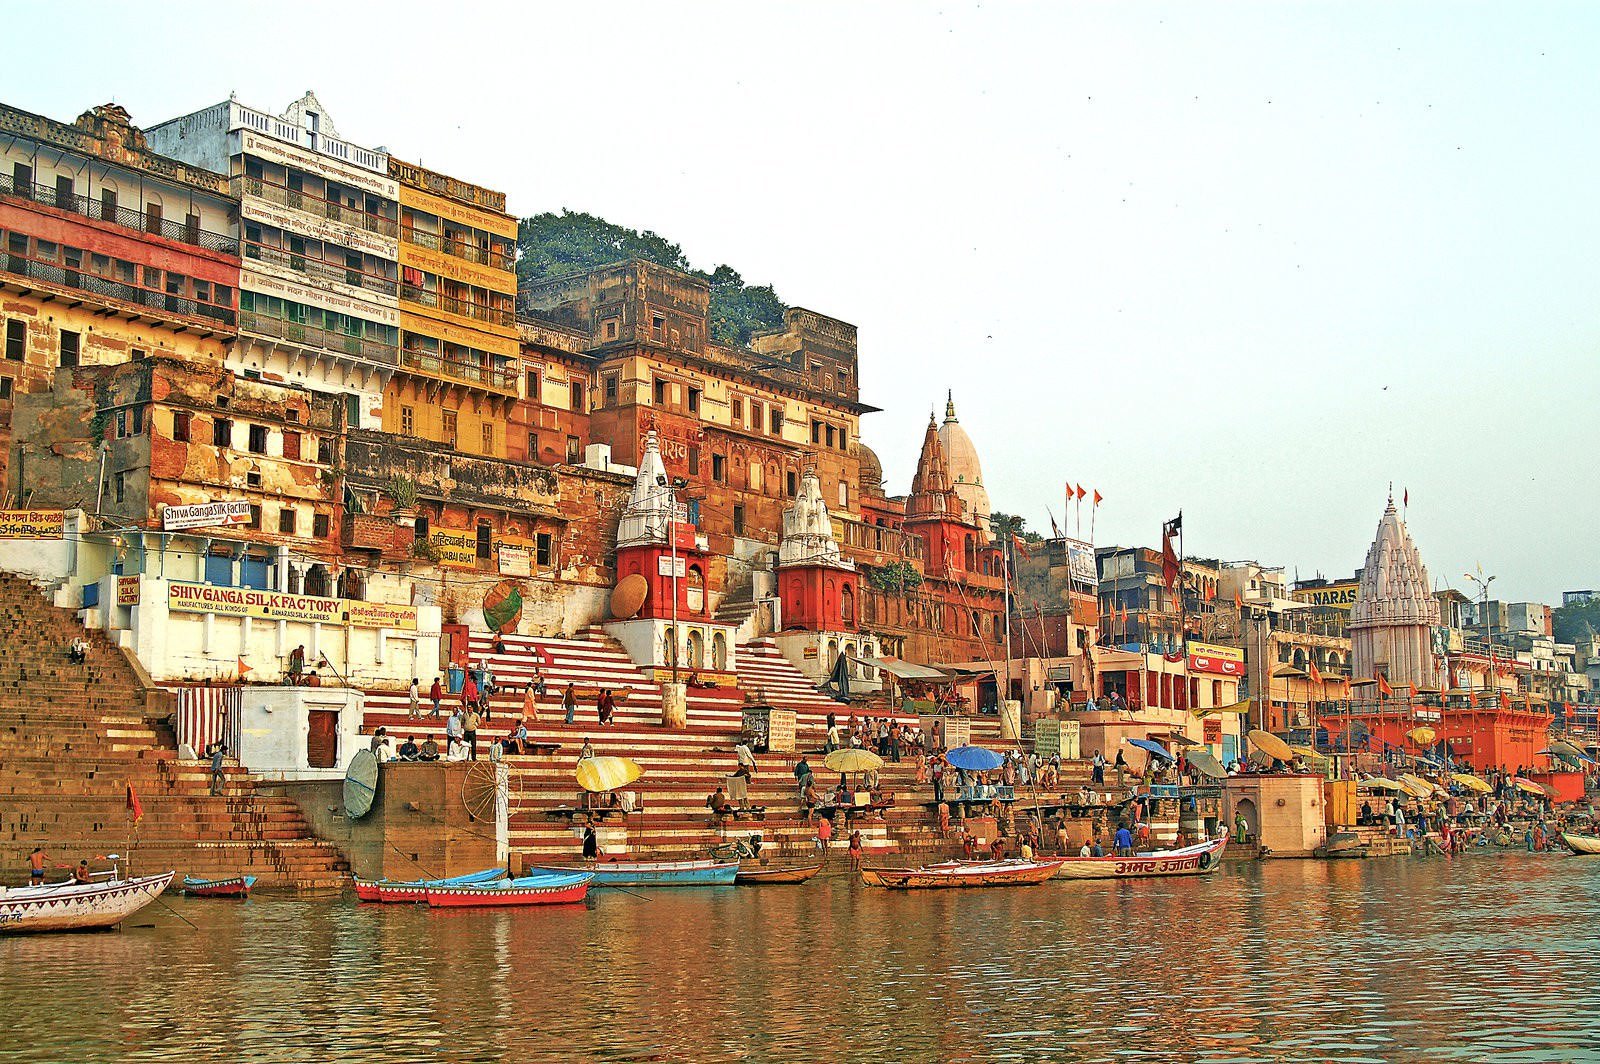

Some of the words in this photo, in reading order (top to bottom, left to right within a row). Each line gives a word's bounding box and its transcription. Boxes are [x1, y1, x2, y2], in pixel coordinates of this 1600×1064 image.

[246, 593, 280, 608] SILK
[282, 596, 340, 613] FACTORY
[1312, 589, 1356, 606] NARAS
[1114, 862, 1156, 874] अमर
[1159, 856, 1199, 872] उजाला
